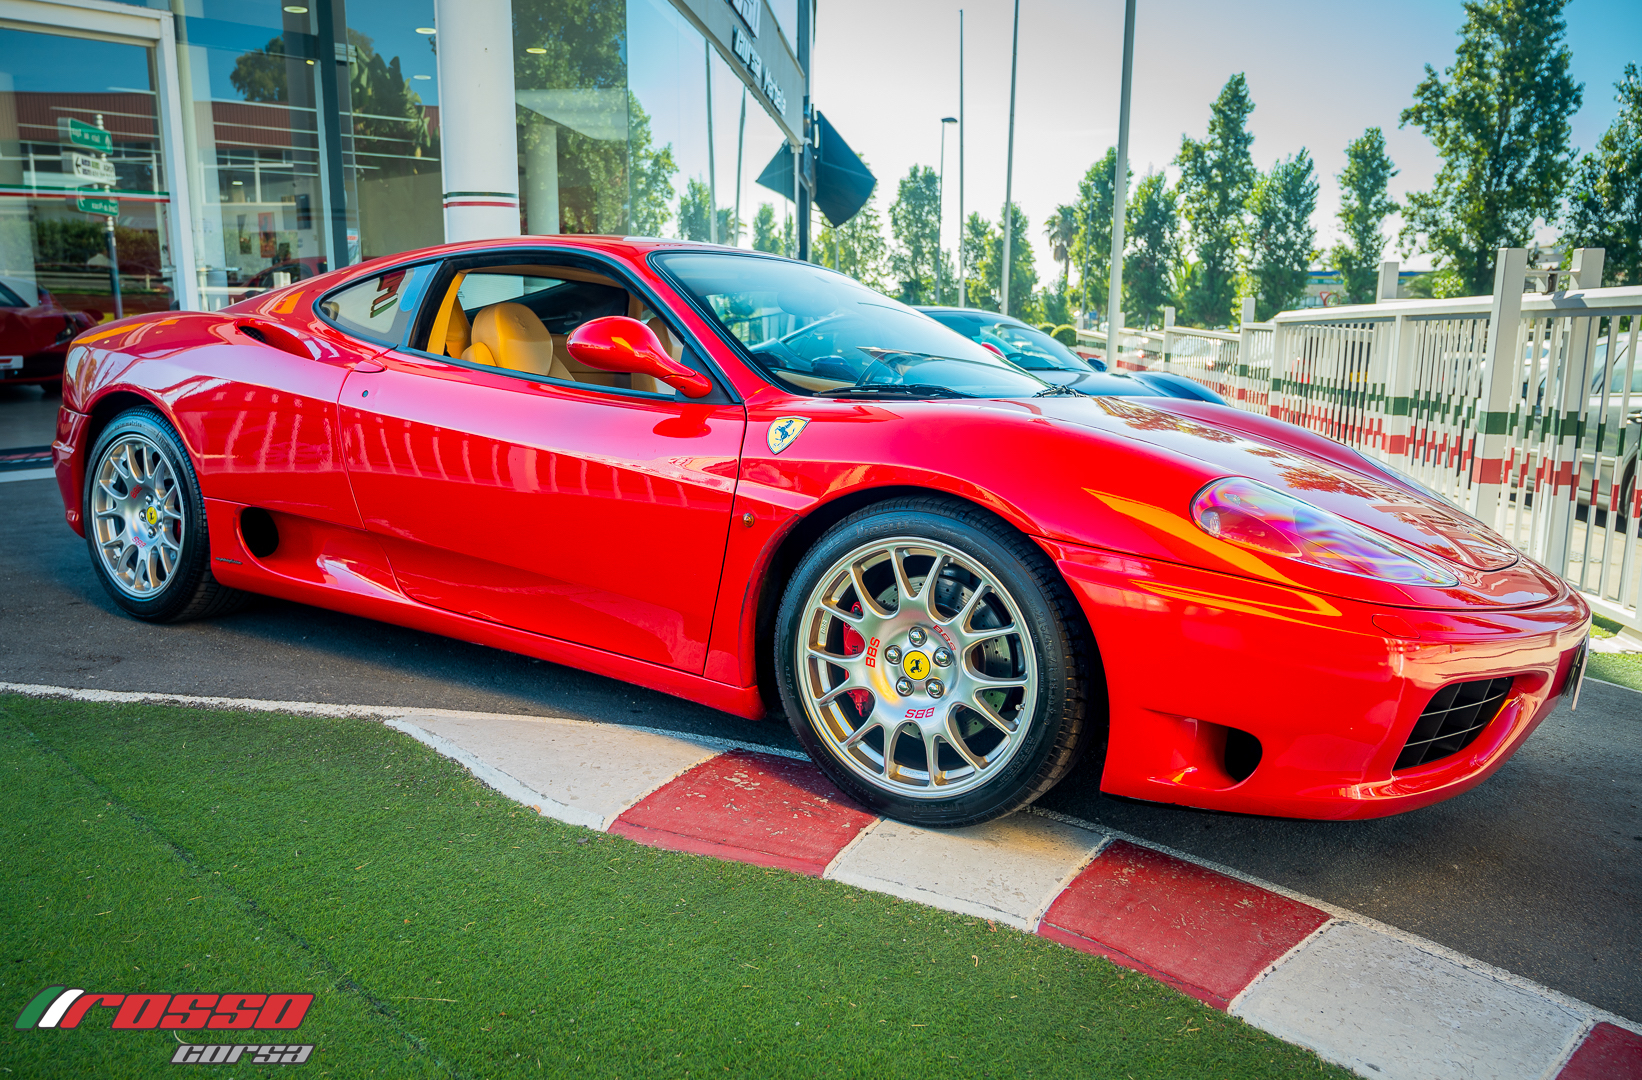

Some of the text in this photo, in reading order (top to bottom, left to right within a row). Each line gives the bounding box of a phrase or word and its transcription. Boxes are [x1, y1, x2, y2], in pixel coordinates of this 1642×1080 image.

[932, 624, 957, 651] BBS
[865, 636, 881, 669] BBS
[904, 706, 935, 719] BBS
